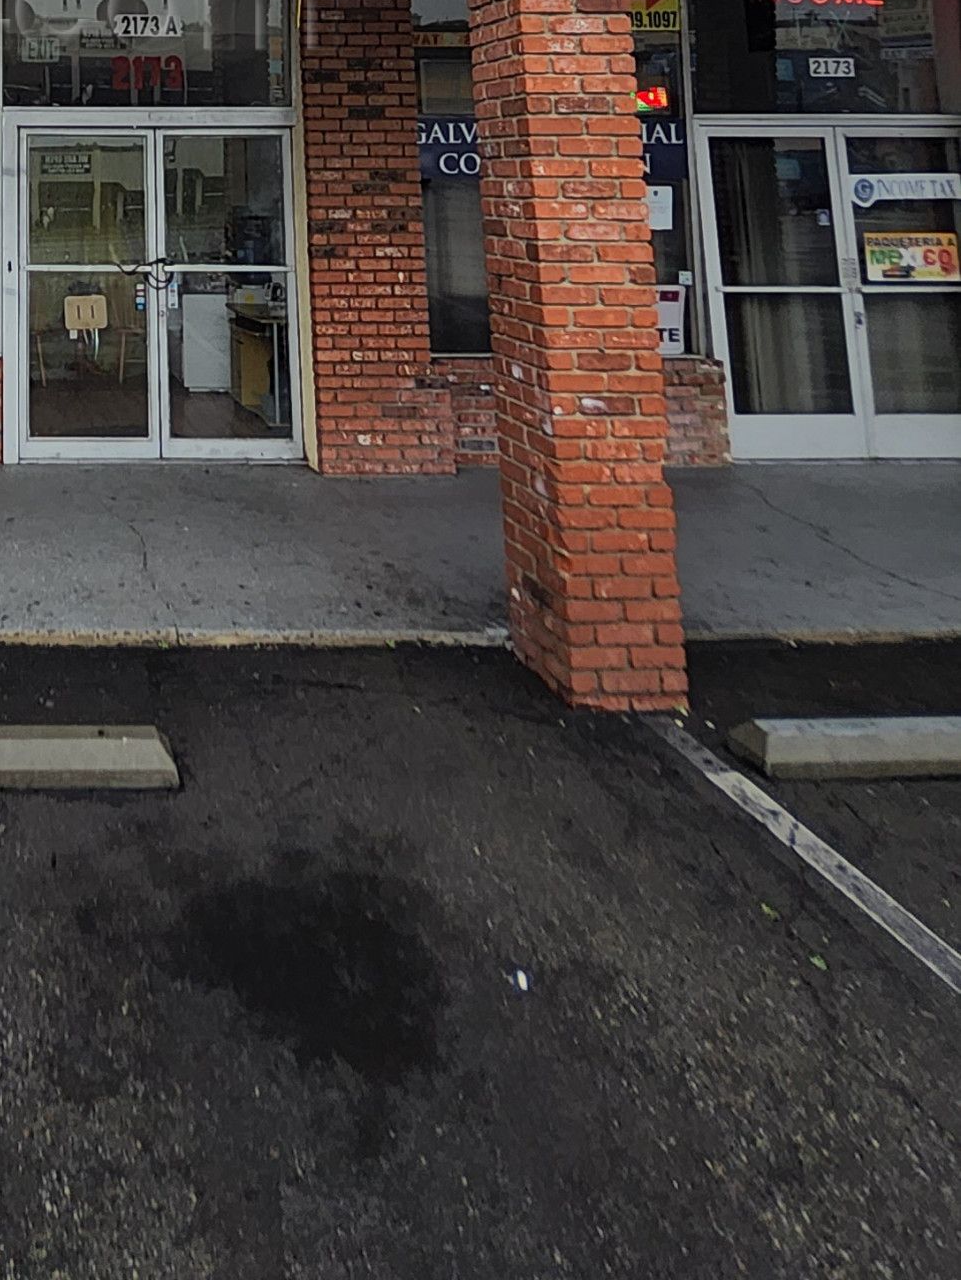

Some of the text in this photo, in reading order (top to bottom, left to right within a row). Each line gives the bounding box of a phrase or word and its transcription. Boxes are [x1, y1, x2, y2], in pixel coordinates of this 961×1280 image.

[120, 16, 178, 35] 2173 A
[812, 60, 852, 75] 2173
